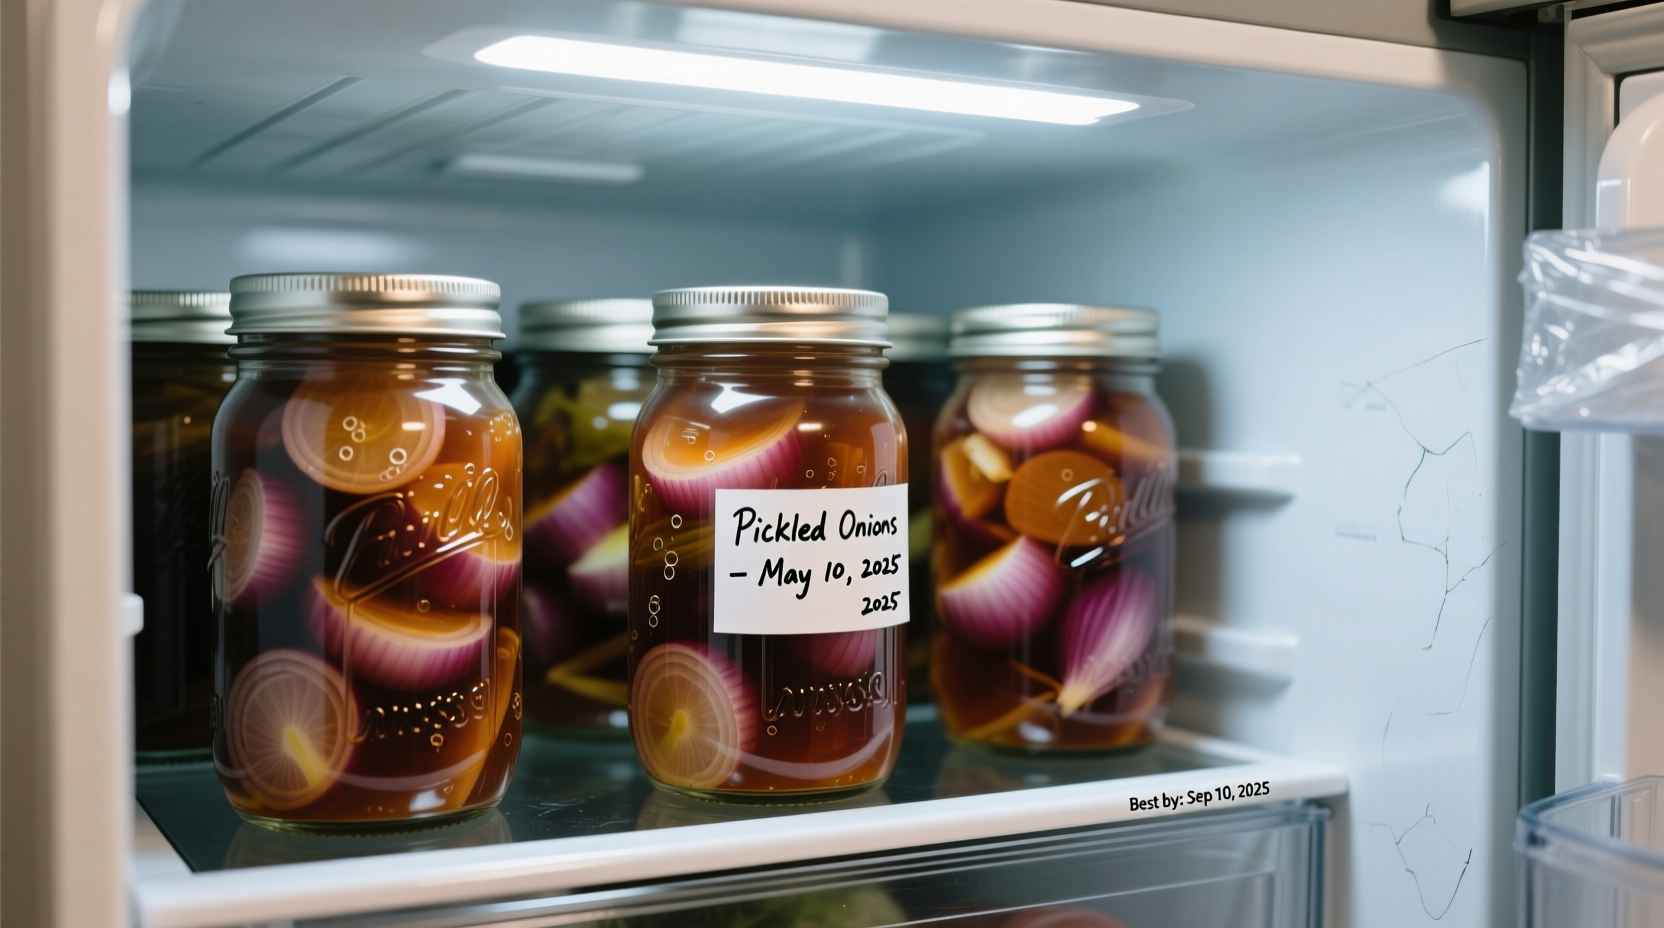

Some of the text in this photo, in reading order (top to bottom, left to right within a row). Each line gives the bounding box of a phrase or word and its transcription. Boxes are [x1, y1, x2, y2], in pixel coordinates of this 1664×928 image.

[733, 506, 898, 547] Pickled Onions
[757, 556, 812, 600] May
[824, 561, 852, 587] 10,
[860, 553, 902, 579] 2025
[860, 590, 902, 616] 2025
[1129, 780, 1270, 812] Best by: Sep 10, 2025
